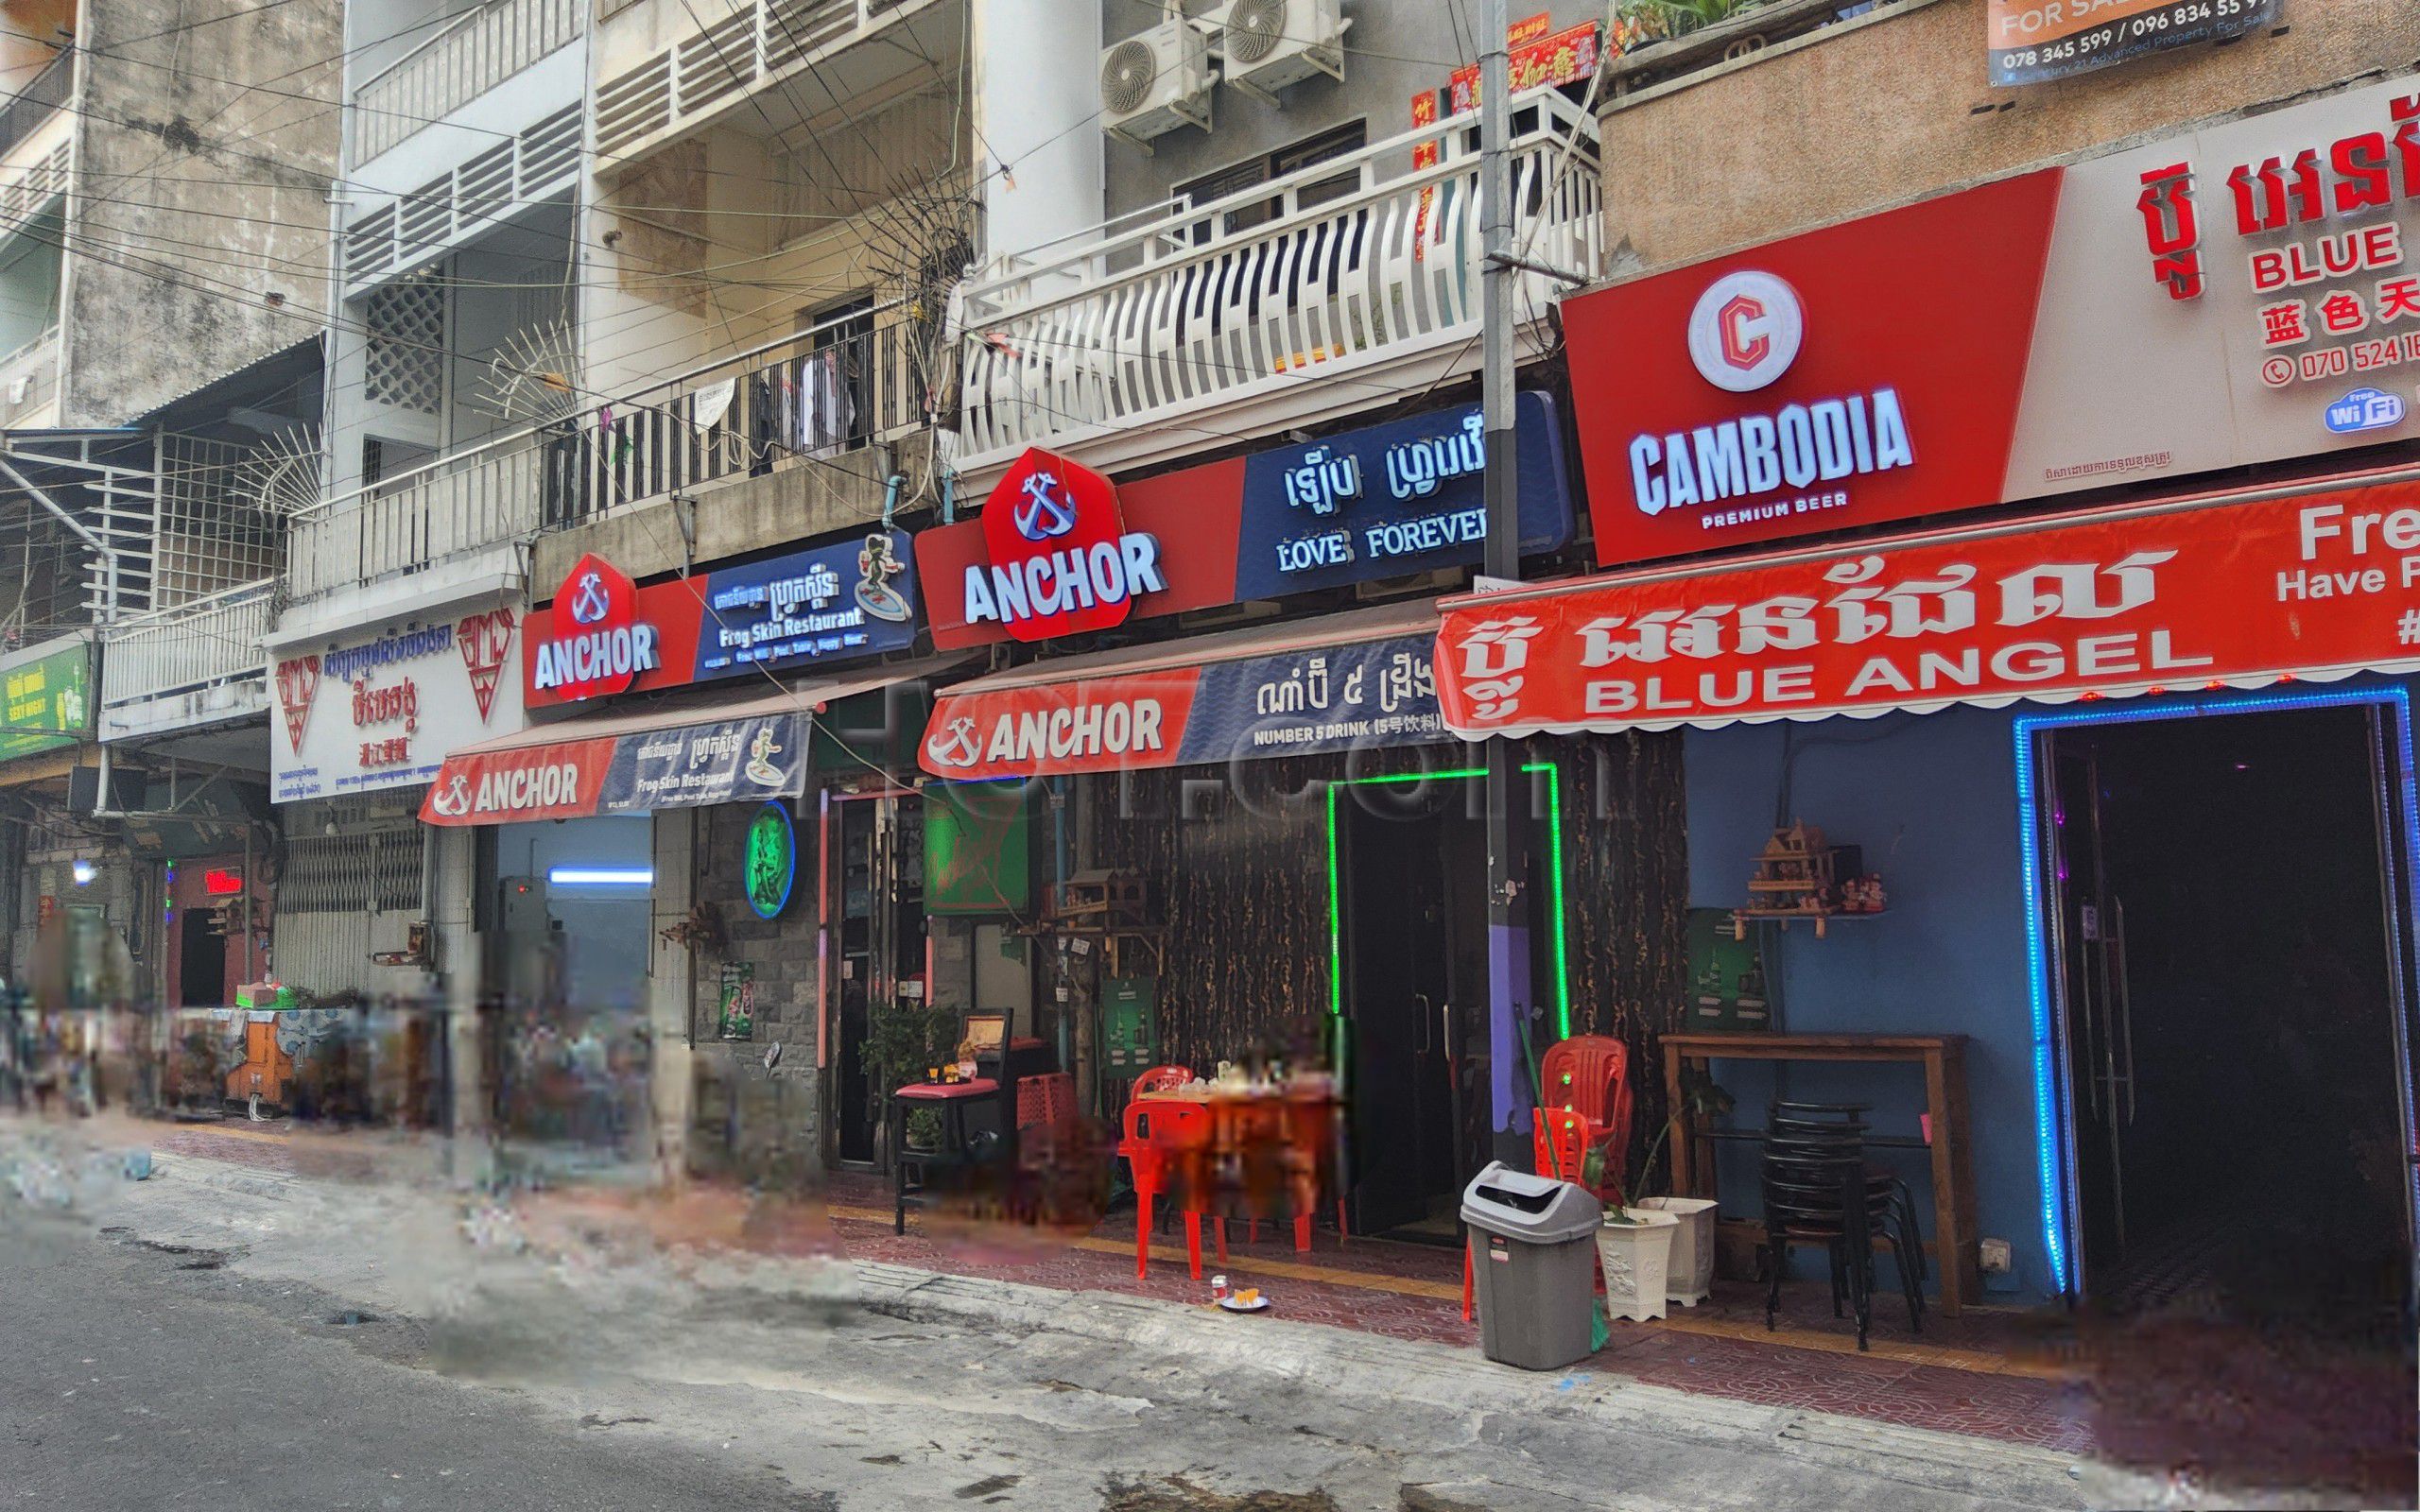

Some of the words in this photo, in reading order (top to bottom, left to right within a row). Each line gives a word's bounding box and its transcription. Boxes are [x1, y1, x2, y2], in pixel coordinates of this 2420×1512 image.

[1999, 2, 2062, 36] FOR
[2003, 51, 2038, 69] 078
[2042, 40, 2075, 63] 345
[2081, 29, 2112, 54] 599
[2132, 13, 2169, 37] 096
[2175, 2, 2211, 26] 834
[2090, 41, 2151, 67] Advanced
[2154, 26, 2214, 52] Property
[2217, 19, 2241, 35] For
[2252, 226, 2399, 291] BLUE
[2302, 350, 2346, 378] 070
[2355, 339, 2398, 369] 524
[2349, 391, 2376, 403] Free
[1628, 387, 1913, 517] CAMBODIA
[1701, 499, 1790, 529] PREMIUM
[1795, 491, 1848, 514] BEER
[1276, 533, 1348, 572] LOVE
[962, 532, 1162, 626] ANCHOR
[2276, 569, 2387, 602] Have
[719, 627, 750, 648] Frog
[752, 620, 782, 643] Skin
[784, 607, 863, 637] Restaurant
[534, 625, 654, 690] ANCHOR
[1586, 664, 1816, 714] BLUE
[1844, 629, 2214, 696] ANGEL
[986, 698, 1163, 763] ANCHOR
[1254, 726, 1313, 746] NUMBER
[1316, 727, 1324, 741] 5
[1326, 721, 1370, 741] DRINK
[475, 763, 579, 813] ANCHOR
[636, 778, 659, 794] Frog
[659, 776, 680, 790] Skin
[681, 770, 735, 788] Restaurant
